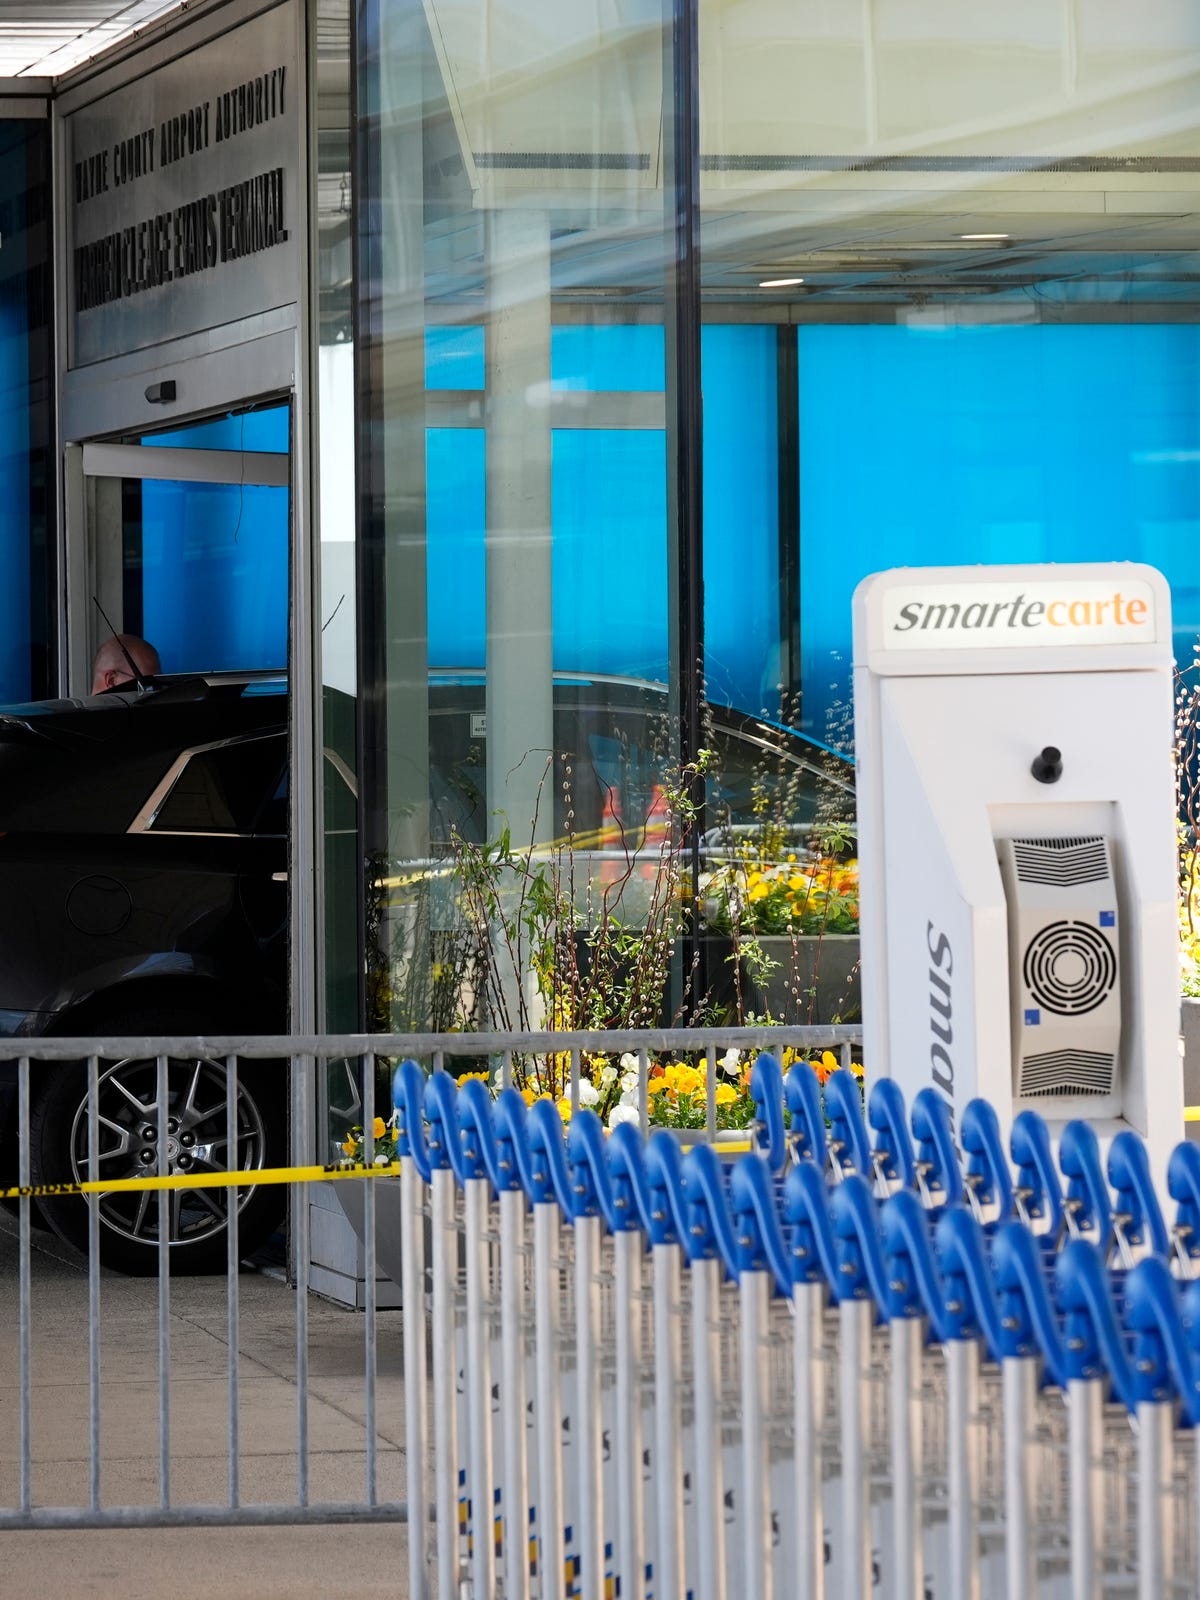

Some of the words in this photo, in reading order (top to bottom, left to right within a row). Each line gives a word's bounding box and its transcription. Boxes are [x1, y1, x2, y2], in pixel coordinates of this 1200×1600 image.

[114, 127, 155, 188] COUNTY
[161, 101, 210, 168] AIRPORT
[215, 65, 286, 144] AUTHORITY
[217, 167, 289, 264] TERMINAL
[893, 592, 1148, 633] smartecarte
